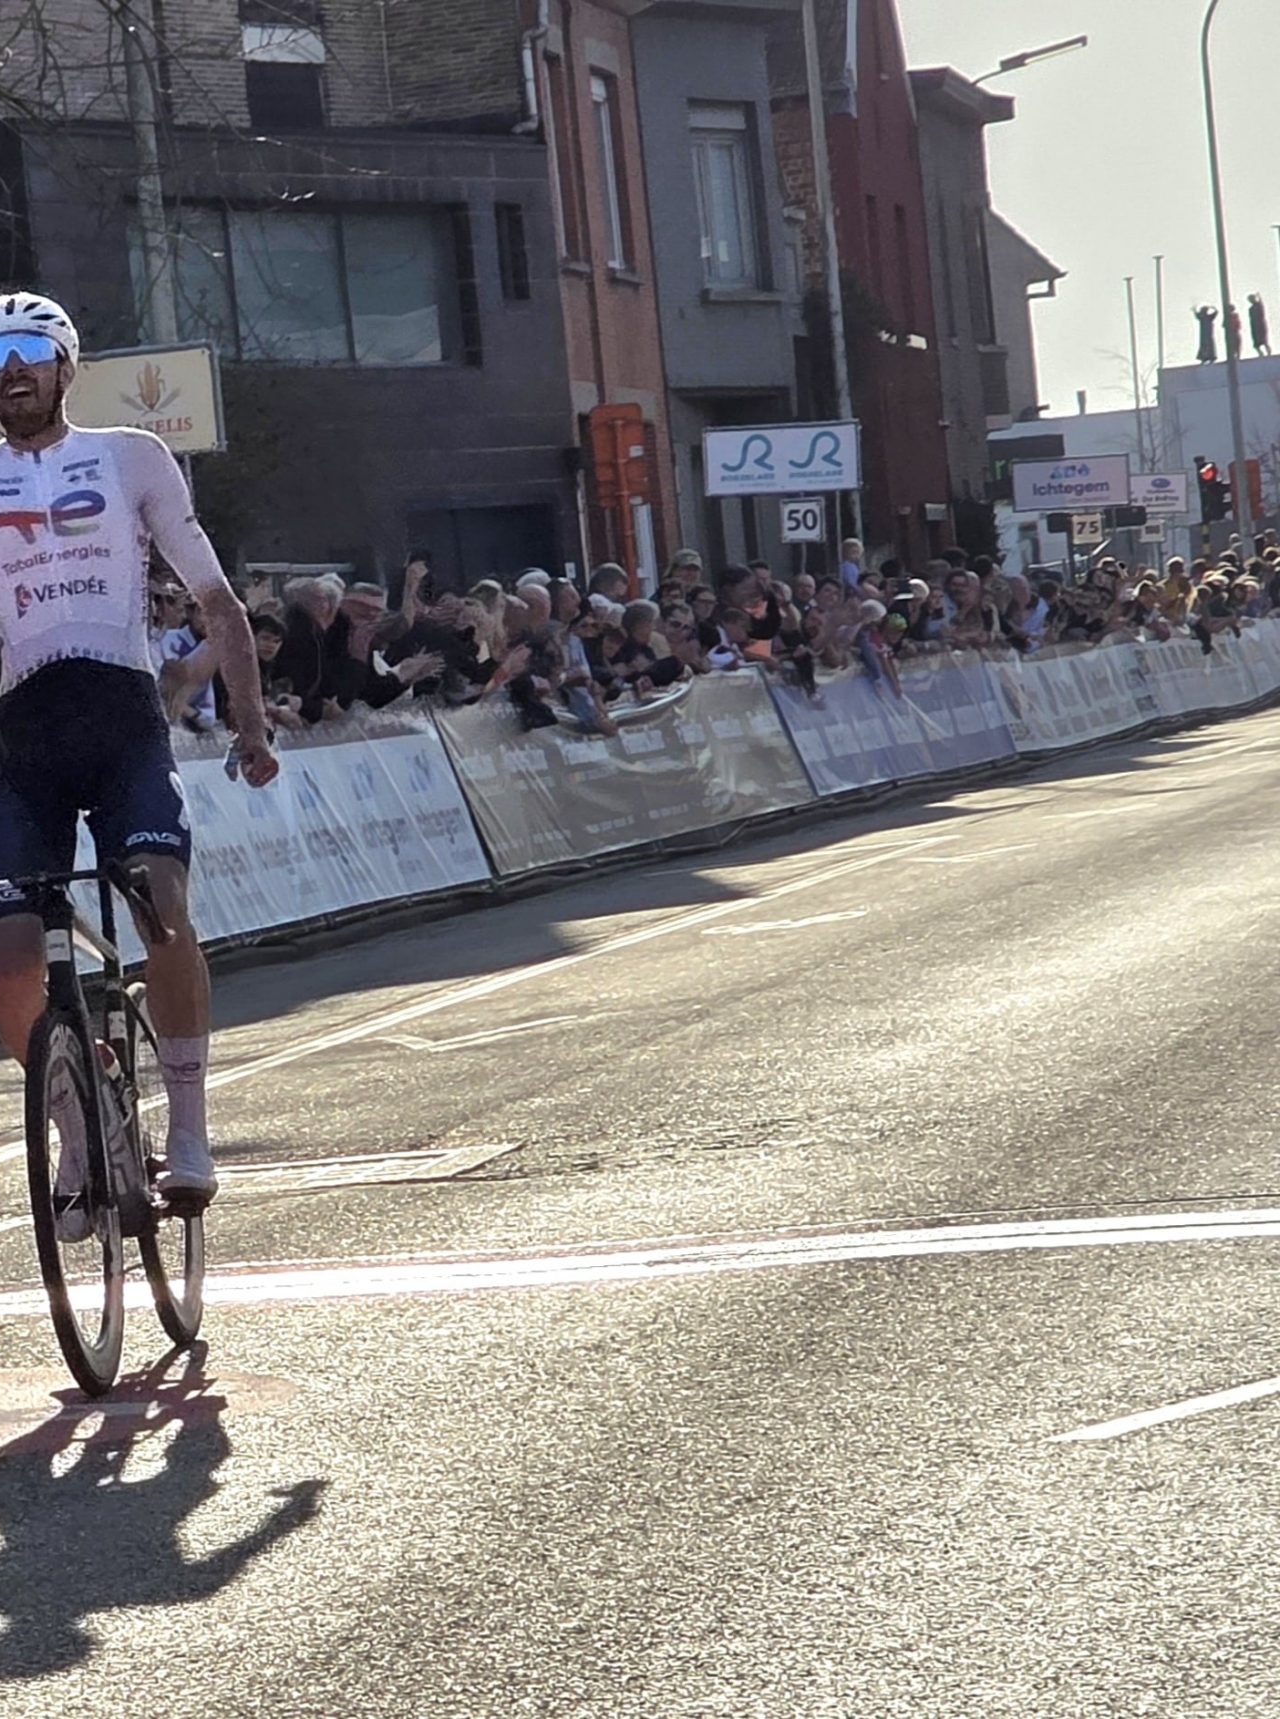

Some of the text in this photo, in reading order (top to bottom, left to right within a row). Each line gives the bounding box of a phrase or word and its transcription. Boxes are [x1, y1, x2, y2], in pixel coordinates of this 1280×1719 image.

[127, 417, 193, 434] SELIS
[1032, 481, 1110, 496] Ichtegem
[786, 509, 818, 531] 50
[1076, 520, 1099, 535] 75
[33, 576, 109, 603] VENDÉE
